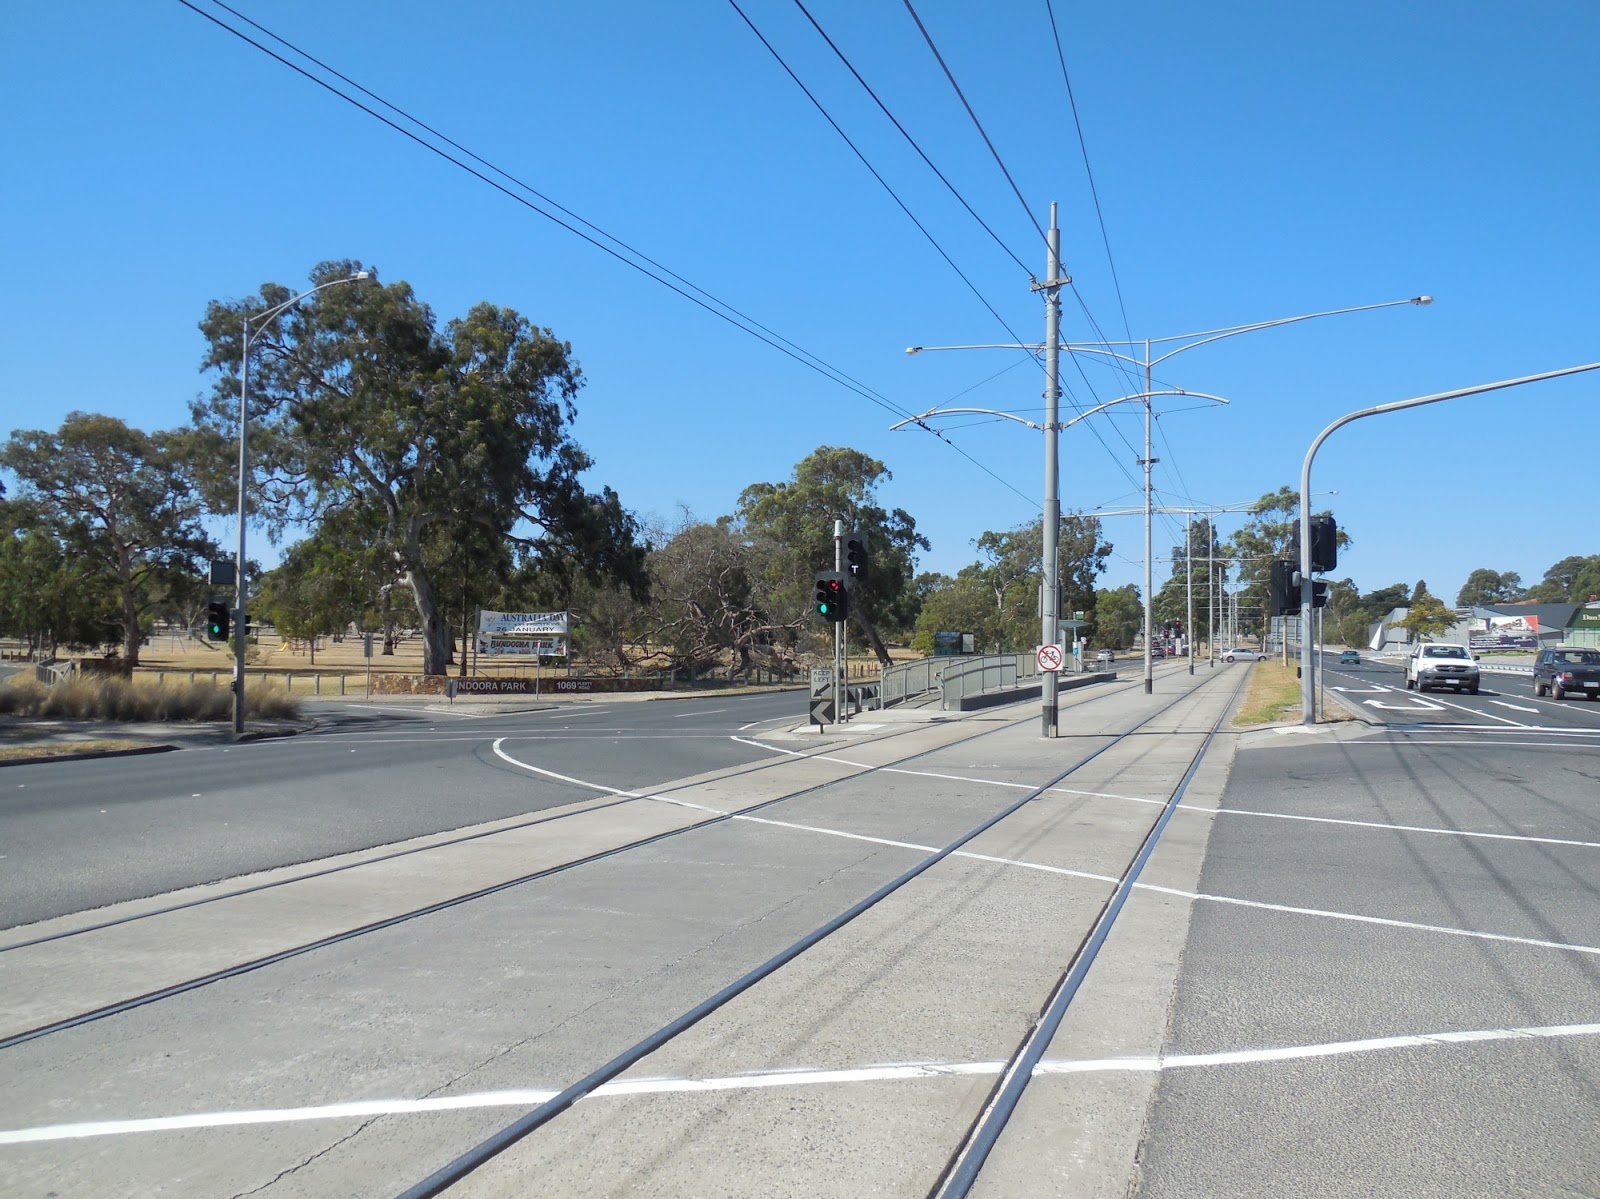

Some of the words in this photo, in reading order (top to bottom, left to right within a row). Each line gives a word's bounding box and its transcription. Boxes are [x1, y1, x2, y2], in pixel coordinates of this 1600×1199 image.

[501, 613, 546, 622] AUSTRALIA
[550, 612, 566, 621] DAY
[490, 640, 530, 648] BUNDOORA
[457, 682, 498, 690] NDOORA
[501, 682, 526, 690] PARK
[556, 682, 577, 690] 1069
